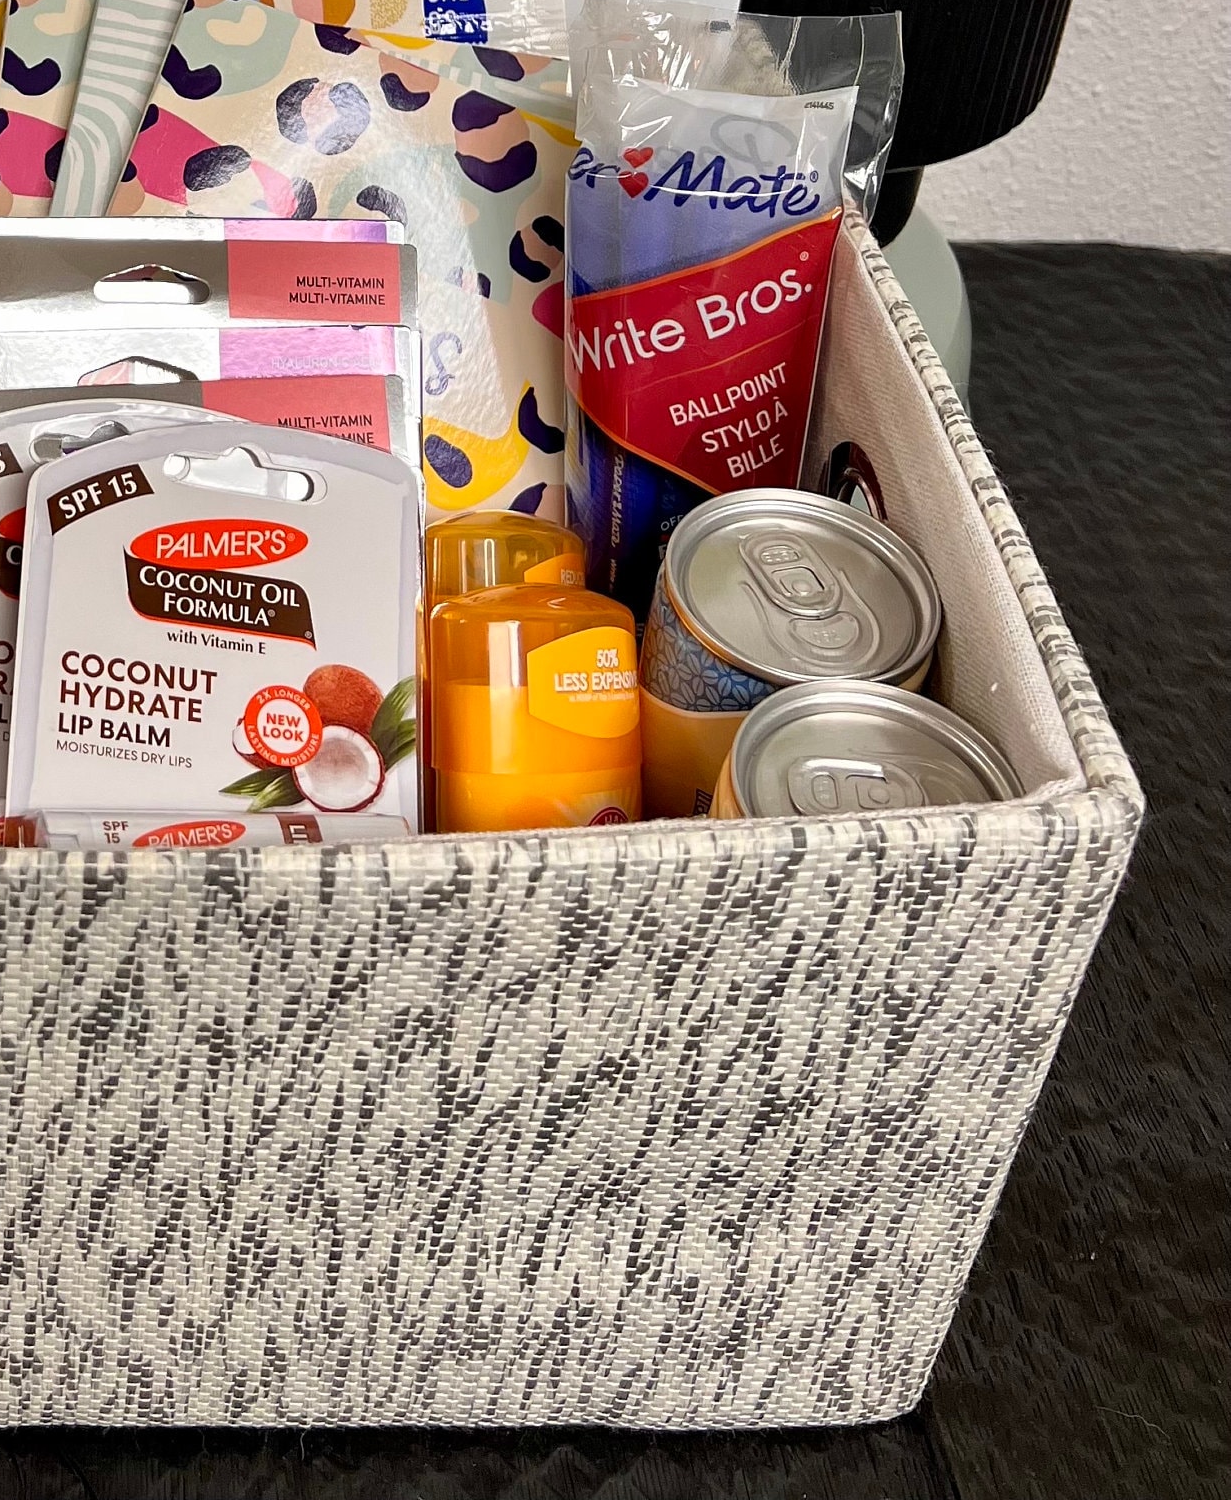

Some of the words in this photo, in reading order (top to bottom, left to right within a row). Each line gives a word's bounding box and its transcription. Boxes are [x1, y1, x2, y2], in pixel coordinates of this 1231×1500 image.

[296, 275, 385, 289] MULTI-VITAMIN
[288, 291, 386, 306] MULTI-VITAMINE
[567, 318, 686, 374] Write
[696, 268, 813, 340] Bros.
[669, 362, 788, 427] BALLPOINT
[701, 410, 771, 453] STYLO
[774, 396, 789, 424] À
[726, 434, 785, 478] BILLE
[57, 483, 103, 519] SPF
[107, 472, 138, 498] 15
[155, 529, 287, 560] PALMER'S
[139, 565, 256, 600] COCONUT
[260, 583, 300, 607] OIL
[163, 591, 270, 626] FORMULA
[167, 629, 198, 646] with
[201, 633, 254, 653] Vitamin
[258, 642, 266, 655] E
[61, 650, 218, 694] COCONUT
[596, 648, 619, 668] 50%
[554, 672, 588, 692] LESS
[59, 680, 203, 724] HYDRATE
[256, 690, 271, 705] 2X
[274, 688, 311, 711] LONGER
[57, 712, 93, 736] LIP
[99, 718, 171, 748] BALM
[262, 726, 304, 742] LOOK
[266, 713, 301, 728] NEW
[56, 739, 138, 762] MOISTURIZES
[141, 751, 166, 767] DRY
[169, 755, 193, 769] LIPS
[247, 724, 278, 763] LASTING
[280, 732, 320, 765] MOISTURE
[102, 820, 129, 831] SPF
[104, 832, 121, 844] 15
[147, 822, 234, 847] PALMER'S
